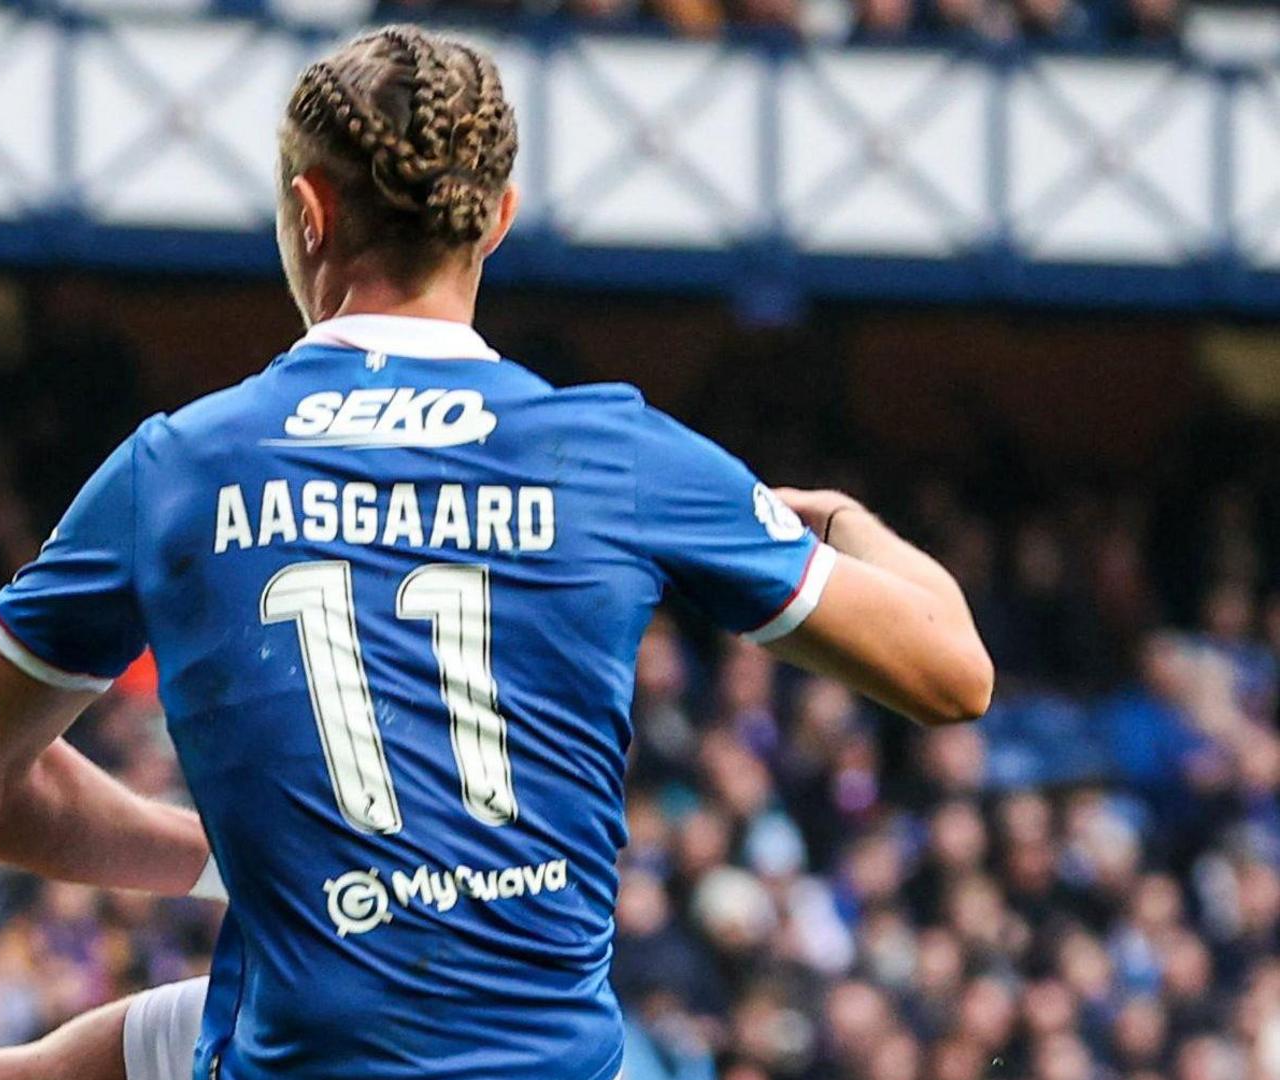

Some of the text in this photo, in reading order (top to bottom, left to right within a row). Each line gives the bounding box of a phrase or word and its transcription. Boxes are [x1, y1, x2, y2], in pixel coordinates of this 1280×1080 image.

[284, 387, 497, 442] SEKO
[213, 479, 556, 553] AASGAARD
[260, 560, 519, 836] 11
